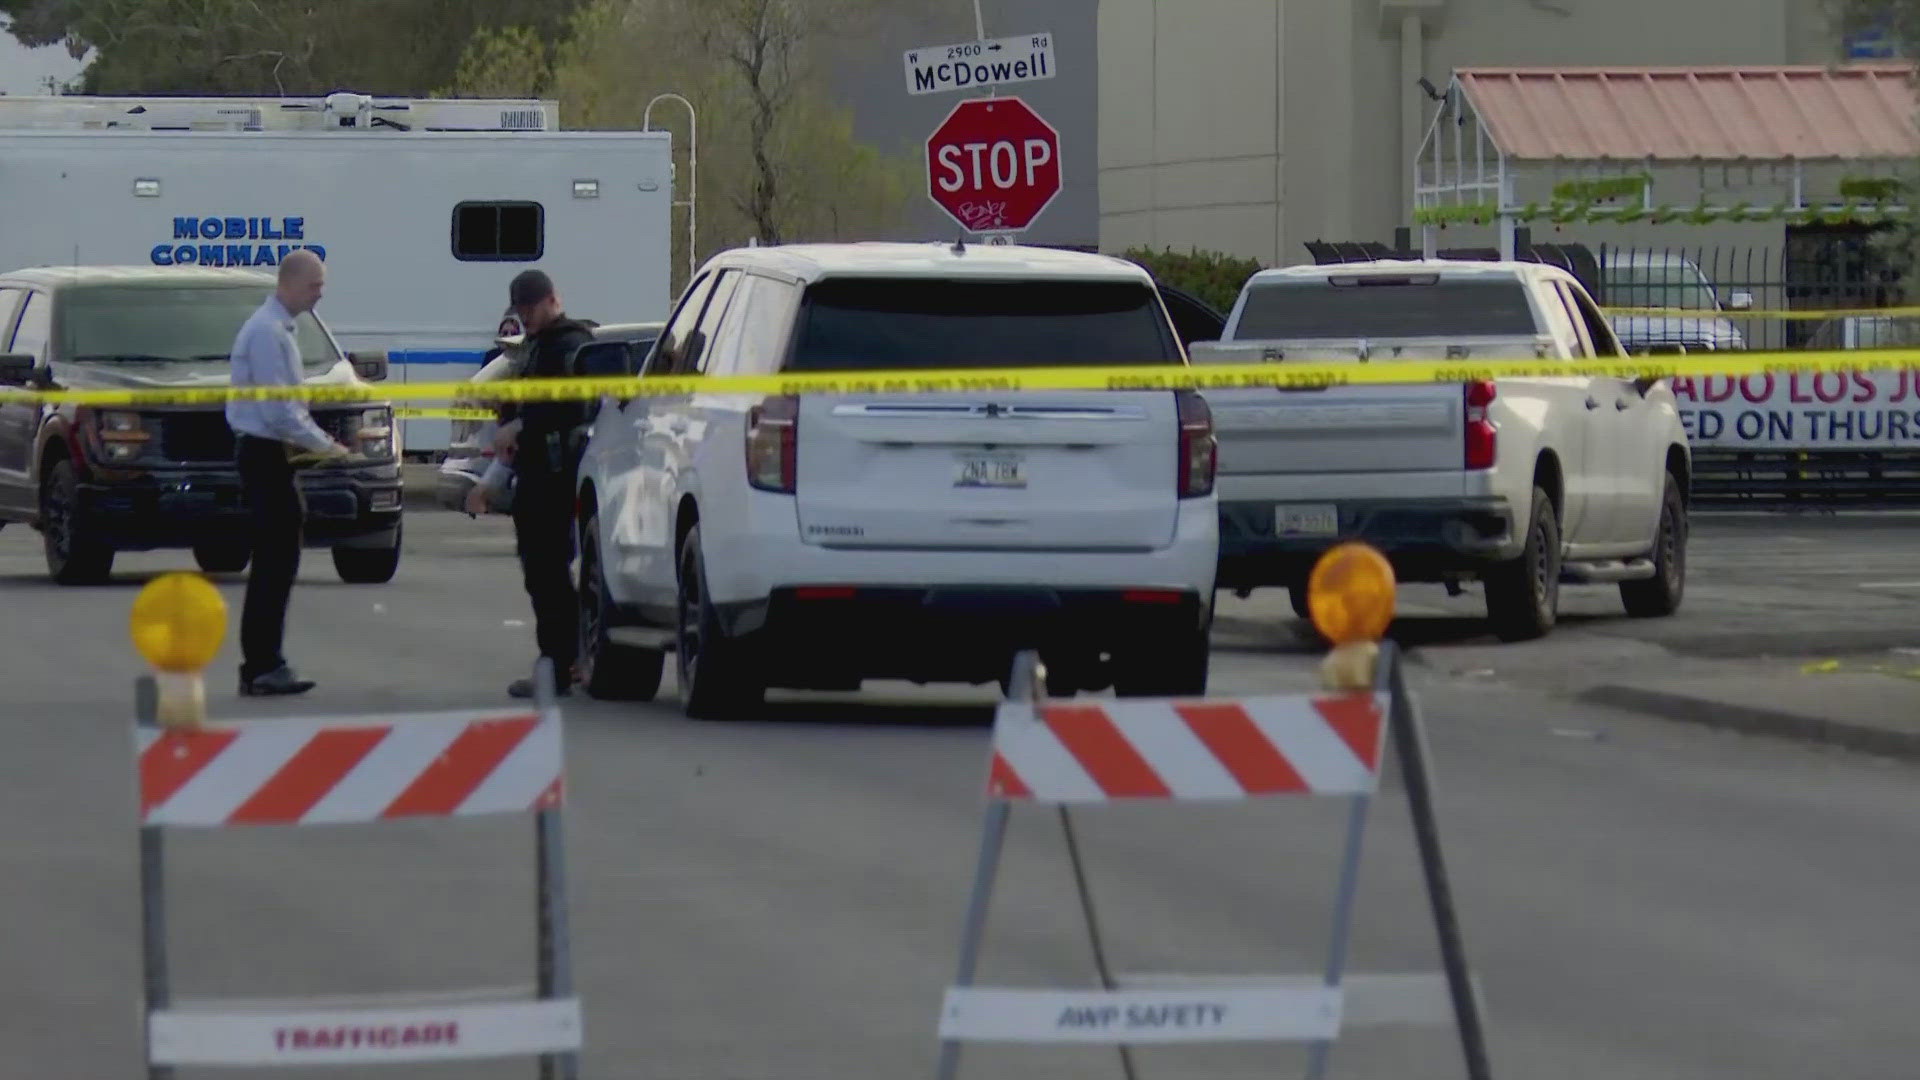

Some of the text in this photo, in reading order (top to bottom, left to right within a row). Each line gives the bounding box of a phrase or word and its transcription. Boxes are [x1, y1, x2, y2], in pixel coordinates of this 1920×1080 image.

[908, 37, 1048, 64] W 2900 Rd
[914, 52, 1047, 91] McDowell
[938, 139, 1051, 192] STOP
[173, 217, 304, 240] MOBILE
[1789, 370, 1877, 404] LOS
[1736, 410, 1793, 441] ON
[1057, 1002, 1228, 1029] AWP SAFETY
